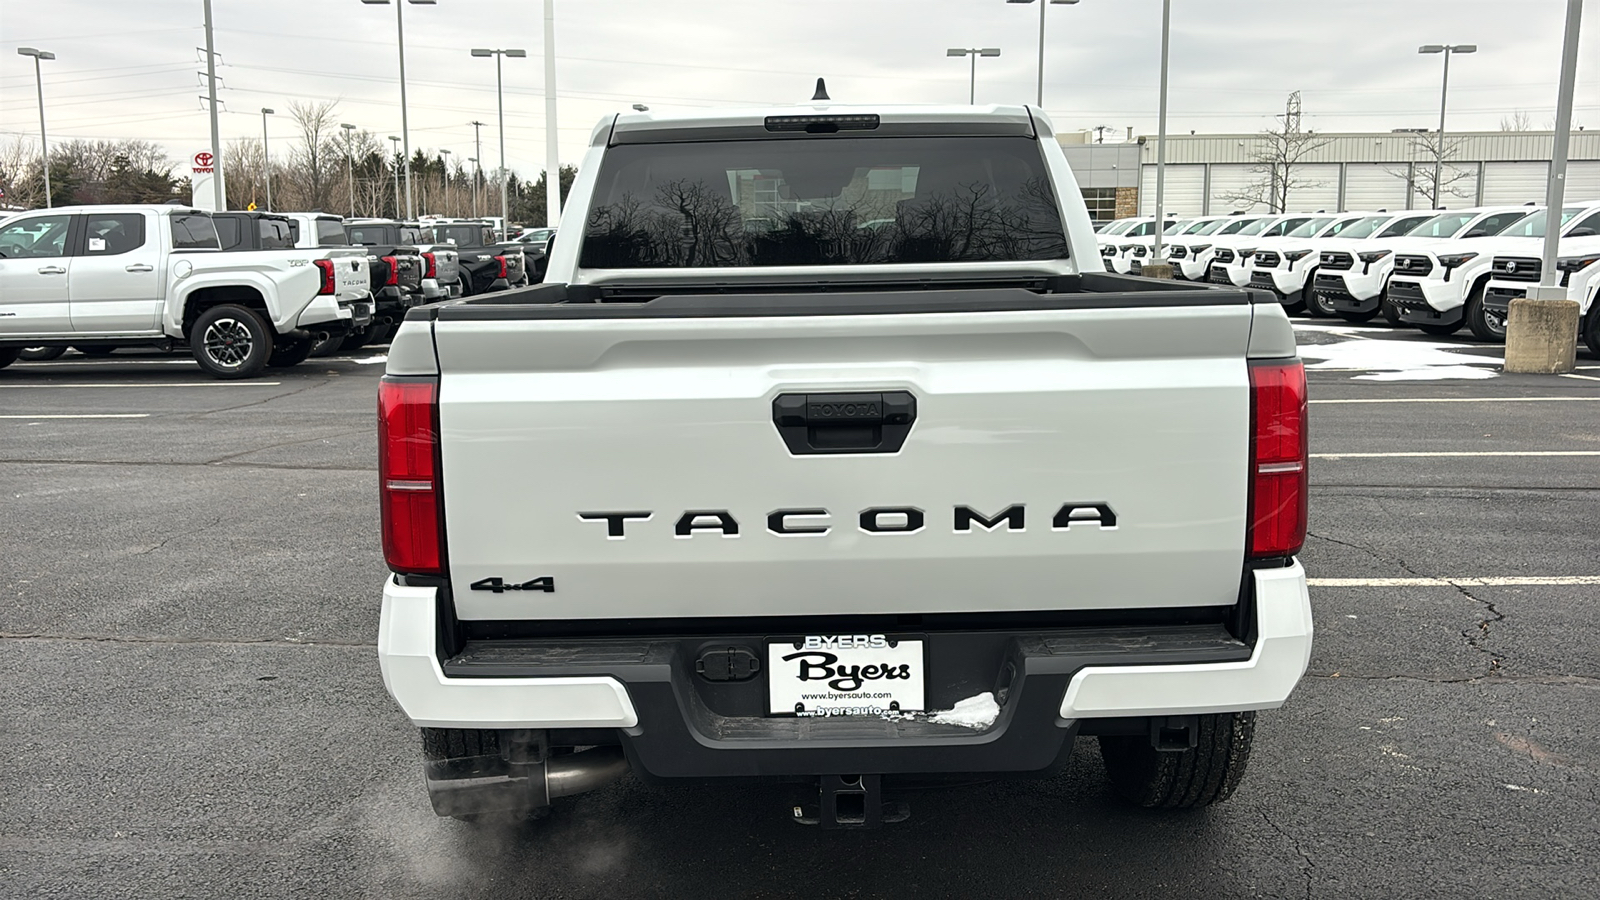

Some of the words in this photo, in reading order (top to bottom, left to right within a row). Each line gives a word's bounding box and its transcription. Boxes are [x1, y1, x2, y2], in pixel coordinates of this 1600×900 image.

[811, 404, 879, 417] TOYOTA
[577, 501, 1118, 540] TACOMA
[470, 576, 555, 594] 4x4
[804, 634, 886, 650] BYERS
[781, 651, 911, 692] Byers
[801, 691, 892, 701] www.byersauto.com
[796, 705, 900, 718] www.byersauto.com
